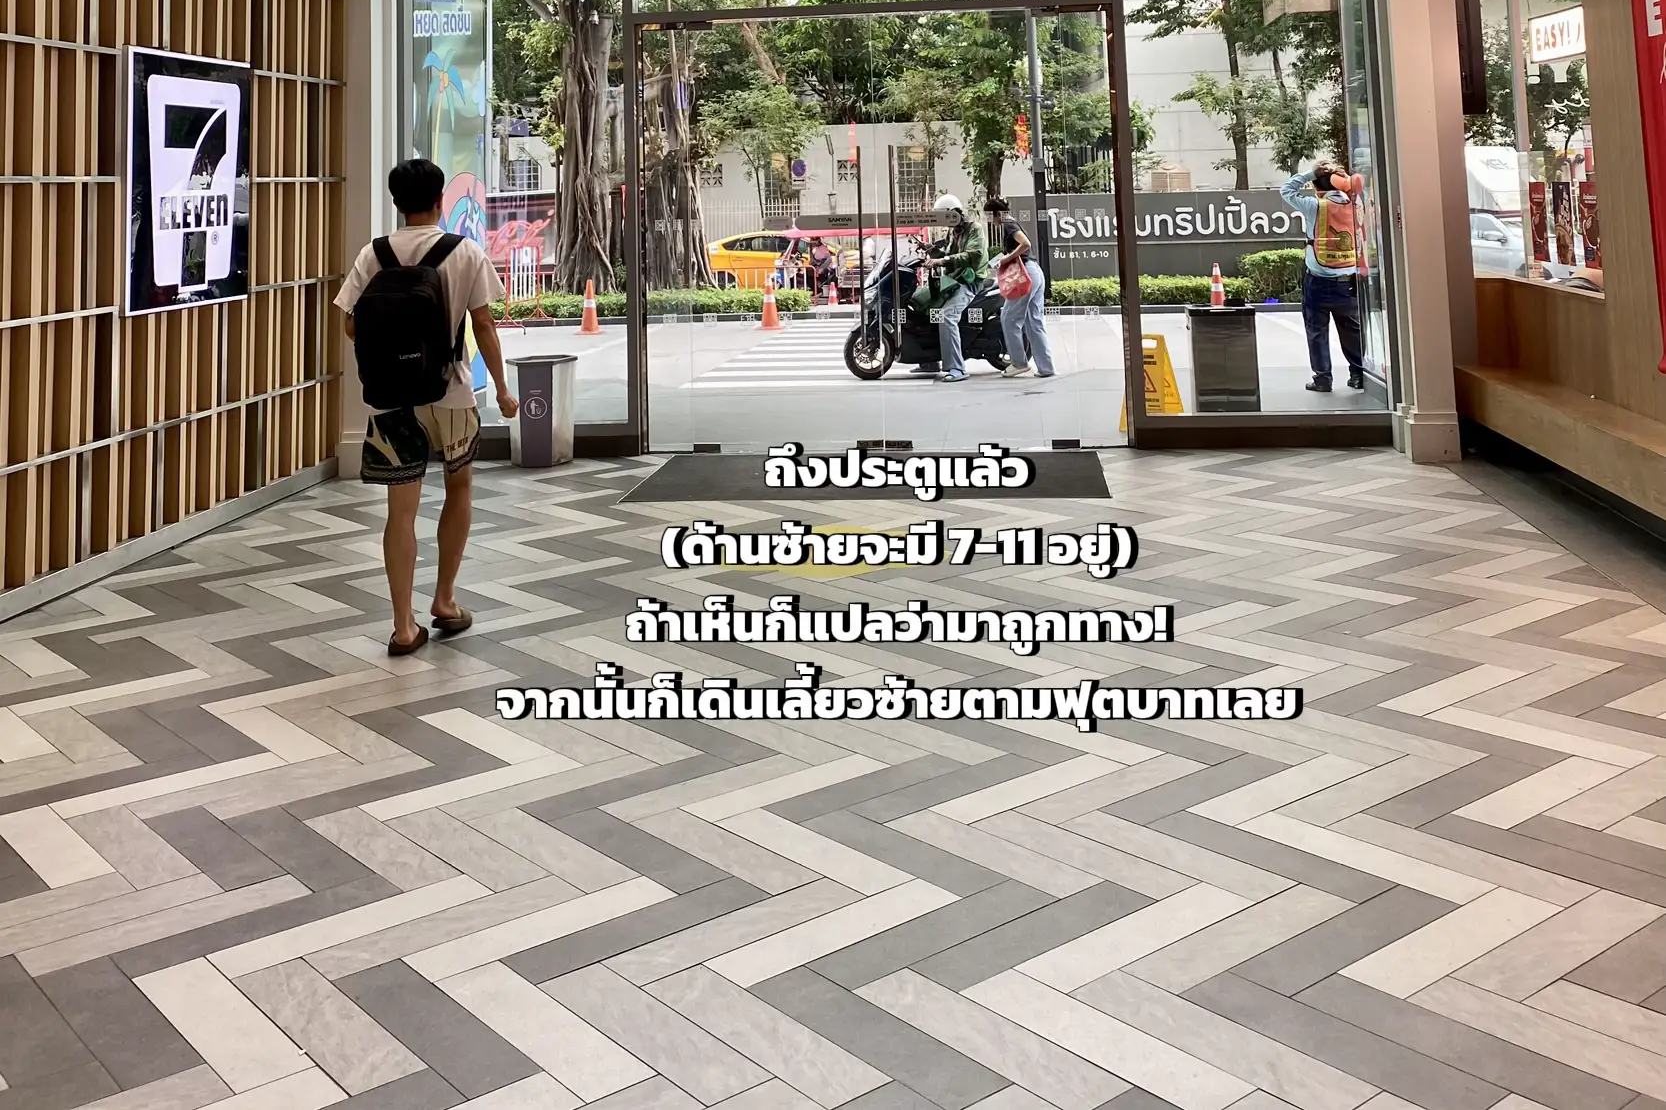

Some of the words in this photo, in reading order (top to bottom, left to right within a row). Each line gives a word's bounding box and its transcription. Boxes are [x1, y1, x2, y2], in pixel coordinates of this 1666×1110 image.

[1535, 19, 1571, 53] EASY!
[1048, 195, 1306, 239] โรงแมทริปเปิ้ลวา
[1053, 247, 1066, 259] ชั้น
[1090, 250, 1109, 258] 6-10
